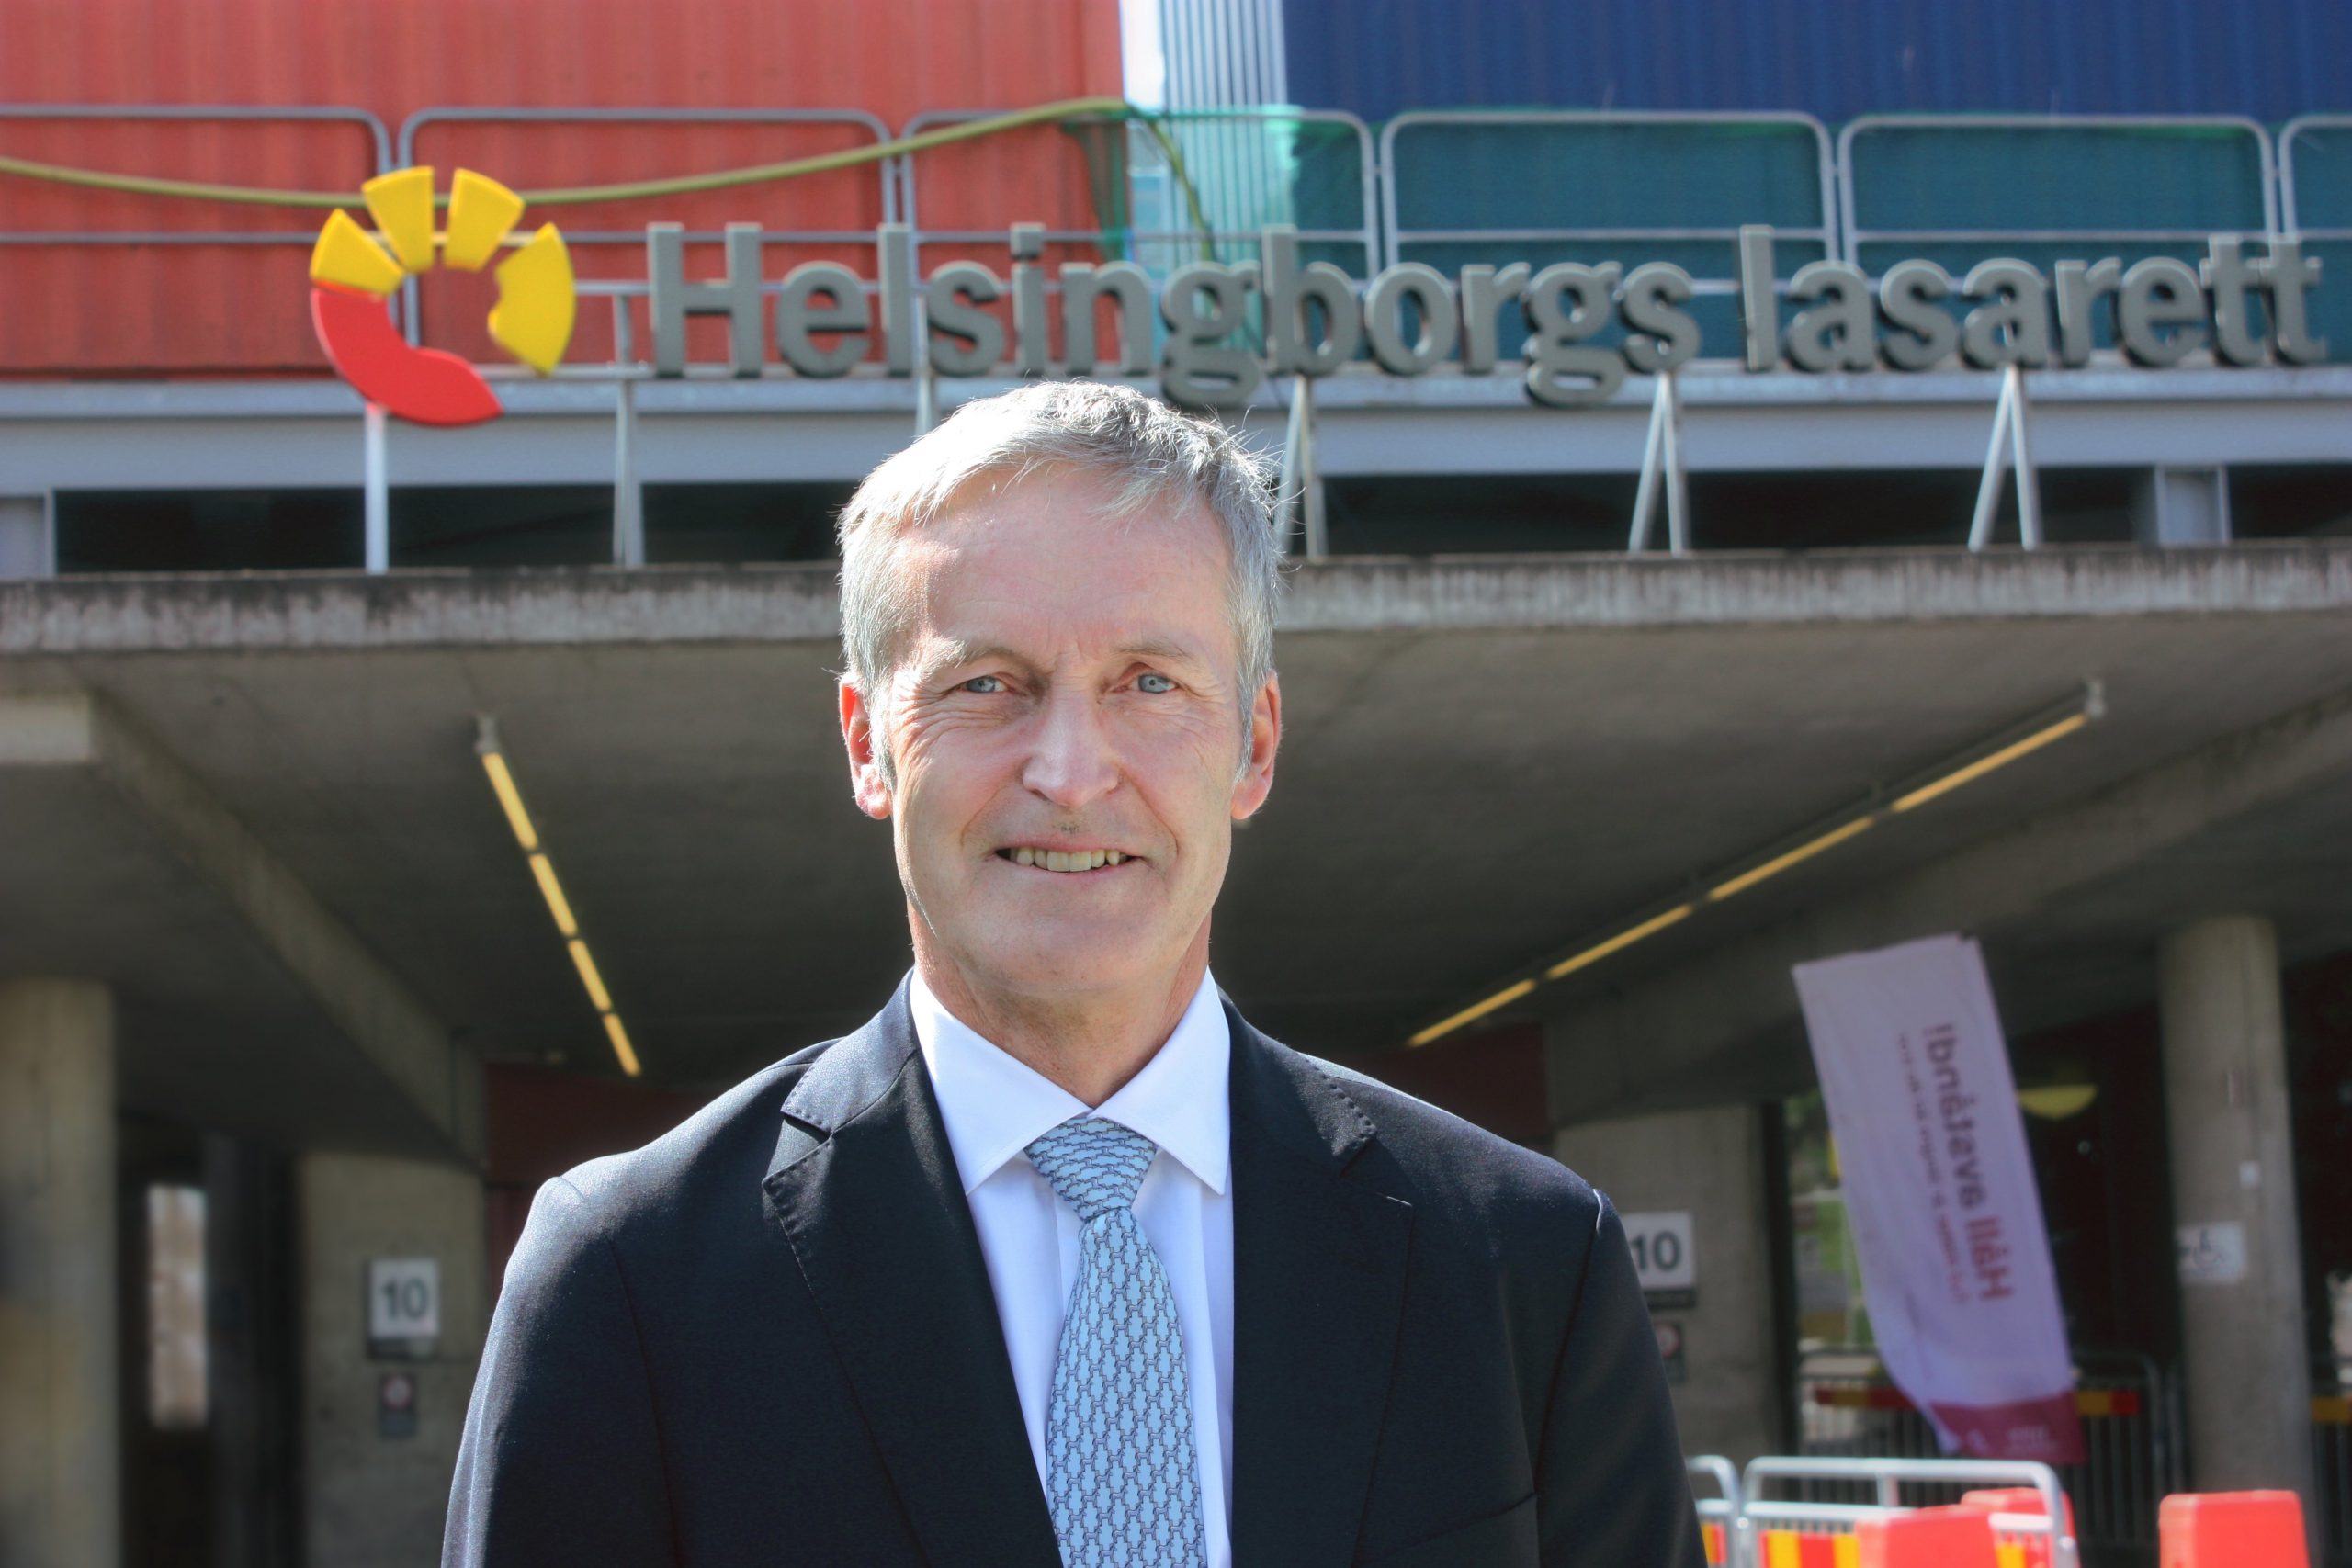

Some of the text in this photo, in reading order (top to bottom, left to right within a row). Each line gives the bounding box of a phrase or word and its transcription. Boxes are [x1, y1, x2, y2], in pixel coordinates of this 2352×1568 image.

[646, 222, 2327, 407] Helsingborgs lasarett
[1631, 1230, 1681, 1272] 10
[382, 1277, 429, 1321] 10
